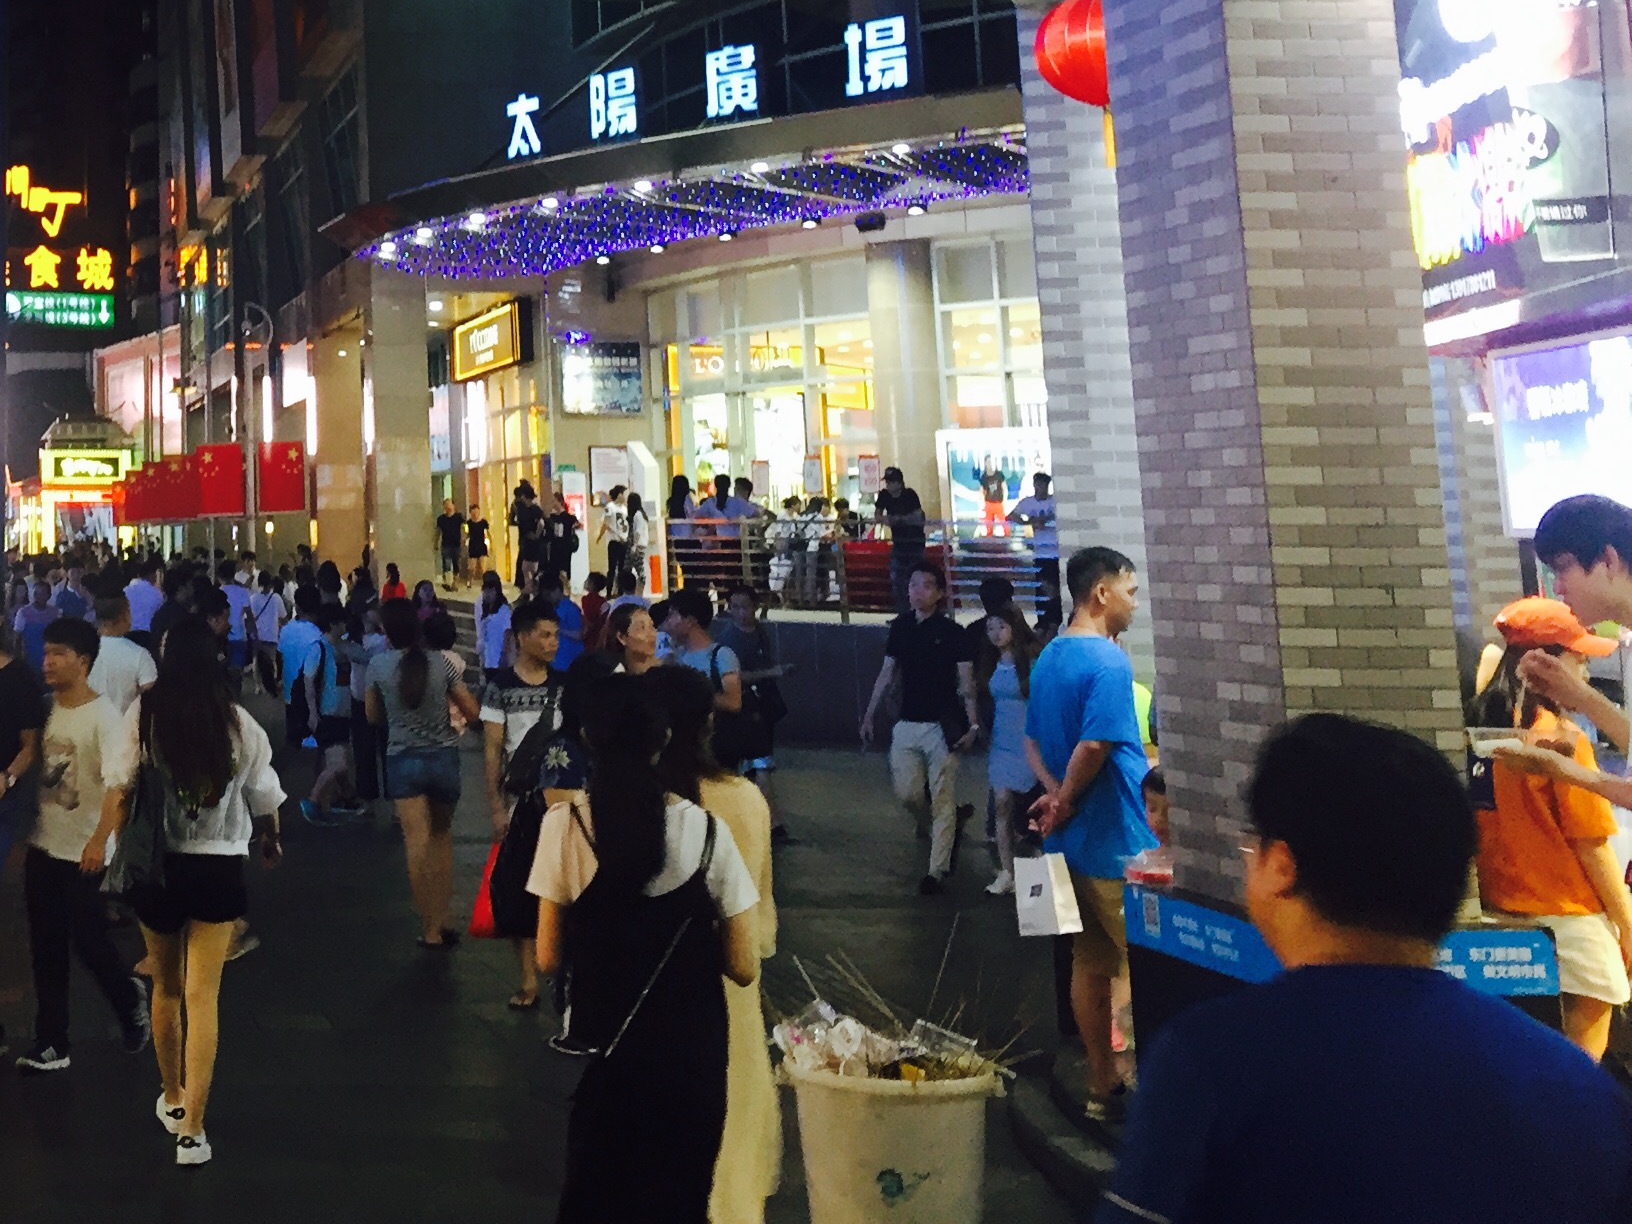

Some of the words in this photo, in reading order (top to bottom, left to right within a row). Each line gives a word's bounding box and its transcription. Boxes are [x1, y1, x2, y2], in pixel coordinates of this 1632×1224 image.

[506, 15, 910, 159] 太陽廣場
[5, 244, 115, 291] 食城
